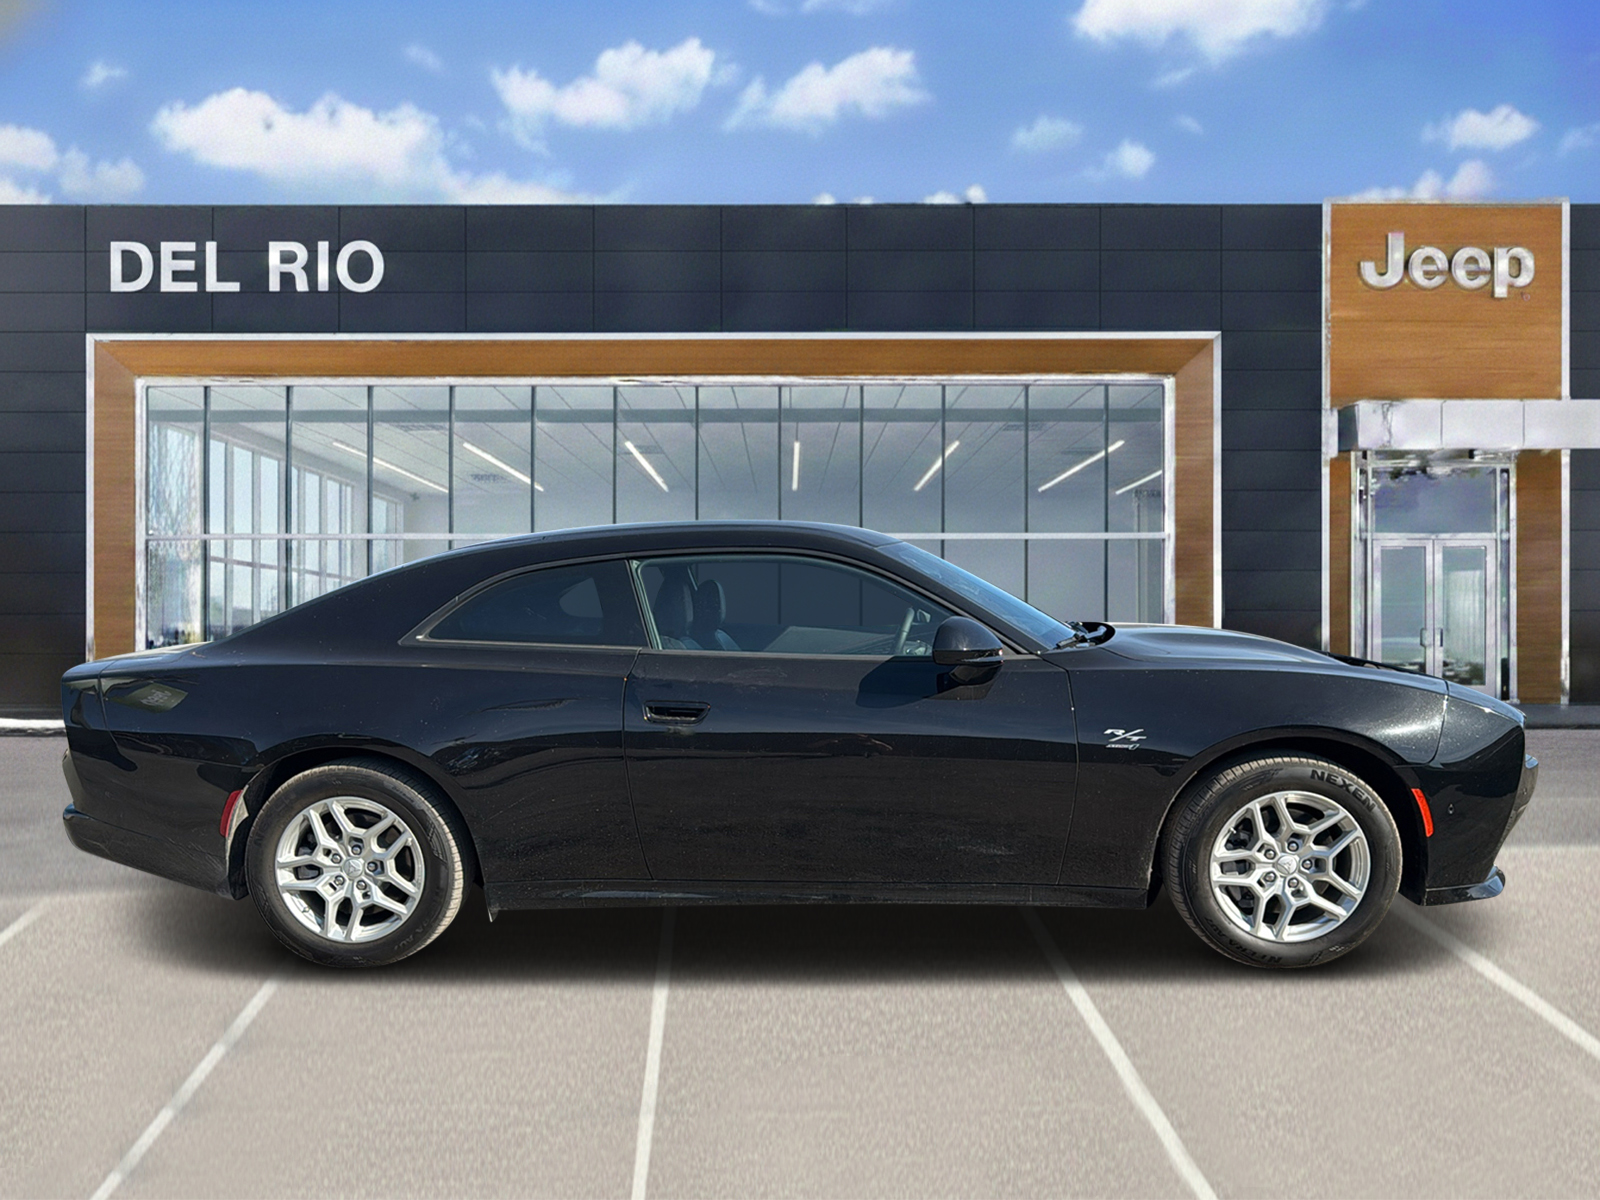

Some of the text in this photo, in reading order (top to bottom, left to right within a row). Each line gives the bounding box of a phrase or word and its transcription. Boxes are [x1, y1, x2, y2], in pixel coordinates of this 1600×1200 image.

[110, 240, 385, 293] DEL RIO
[1359, 231, 1535, 298] Jeep
[1103, 728, 1147, 742] R/T
[1310, 769, 1377, 812] NEXEN
